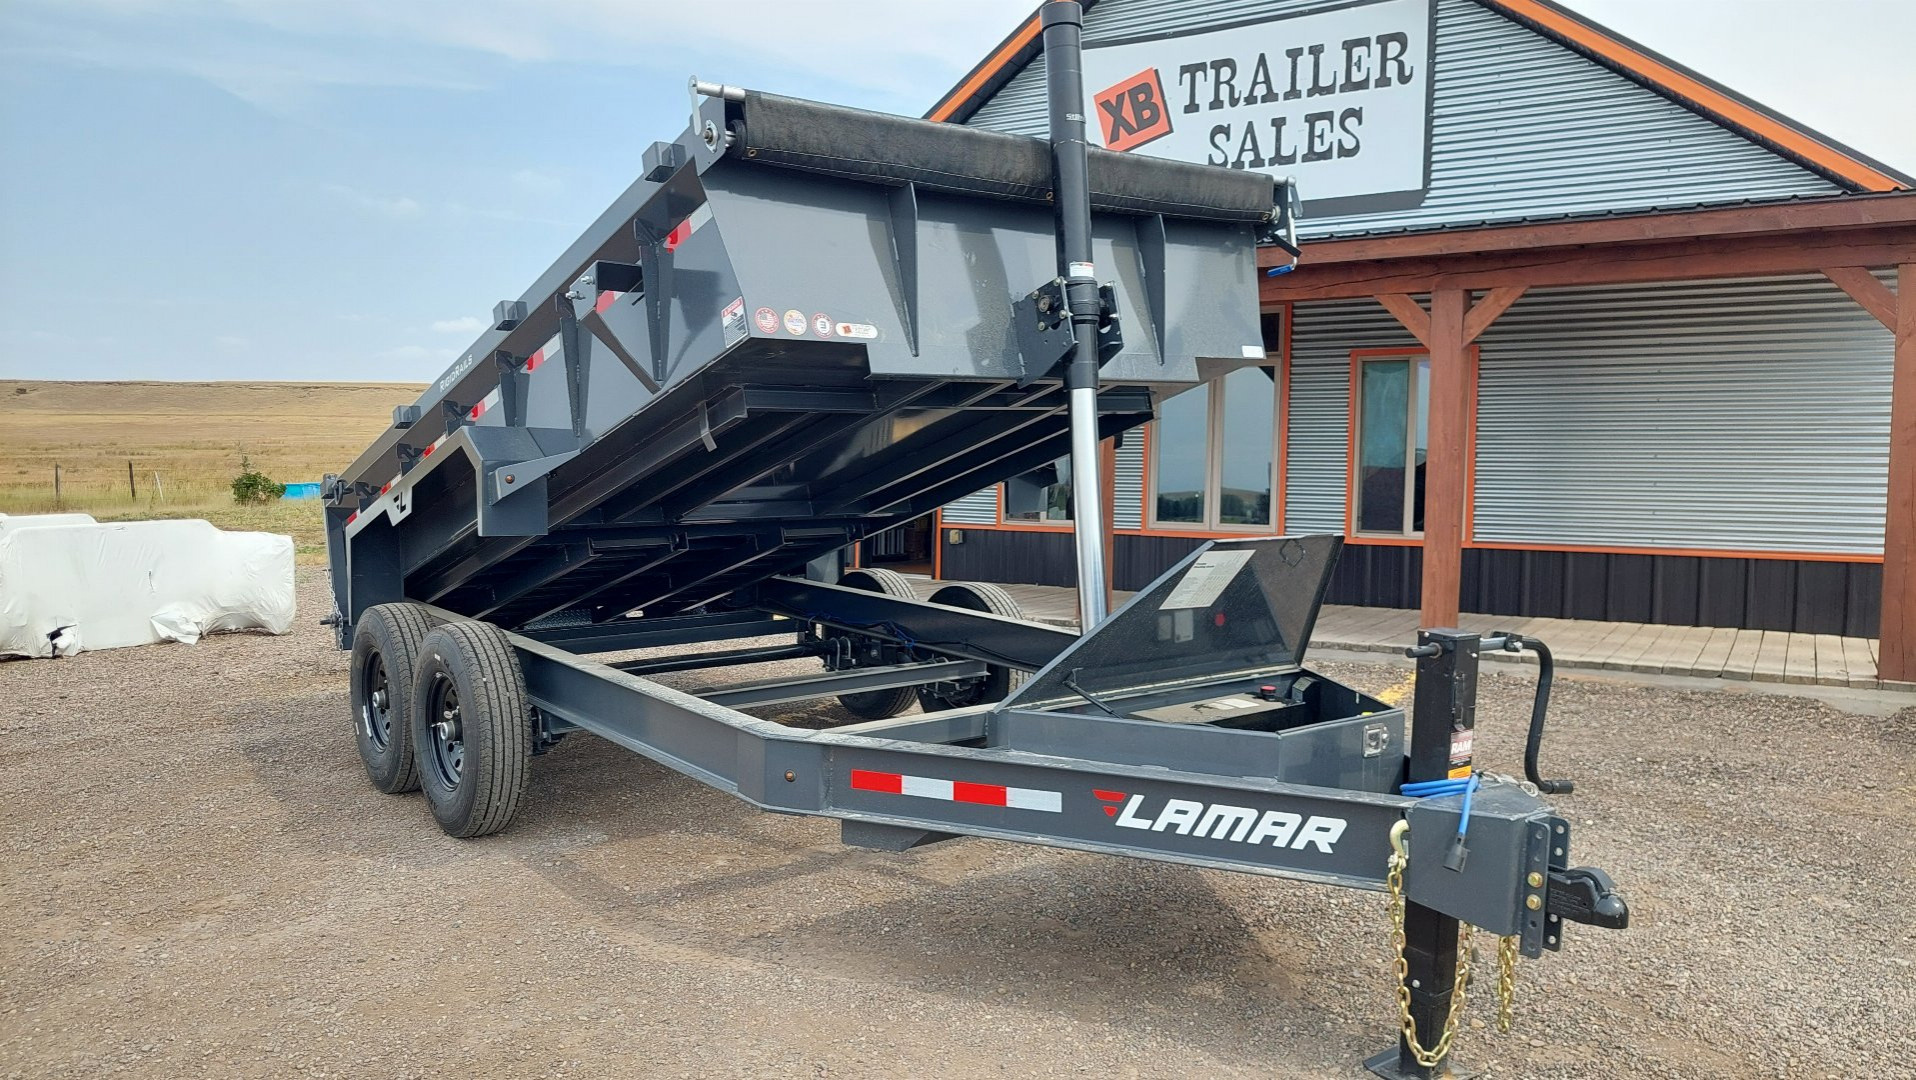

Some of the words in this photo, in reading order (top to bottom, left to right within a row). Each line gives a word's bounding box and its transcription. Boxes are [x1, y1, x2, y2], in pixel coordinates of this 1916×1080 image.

[1178, 31, 1414, 115] TRAILER
[1097, 81, 1161, 145] XB
[1207, 106, 1364, 169] SALES
[1450, 739, 1472, 755] RAM
[1114, 793, 1348, 854] LAMAR
